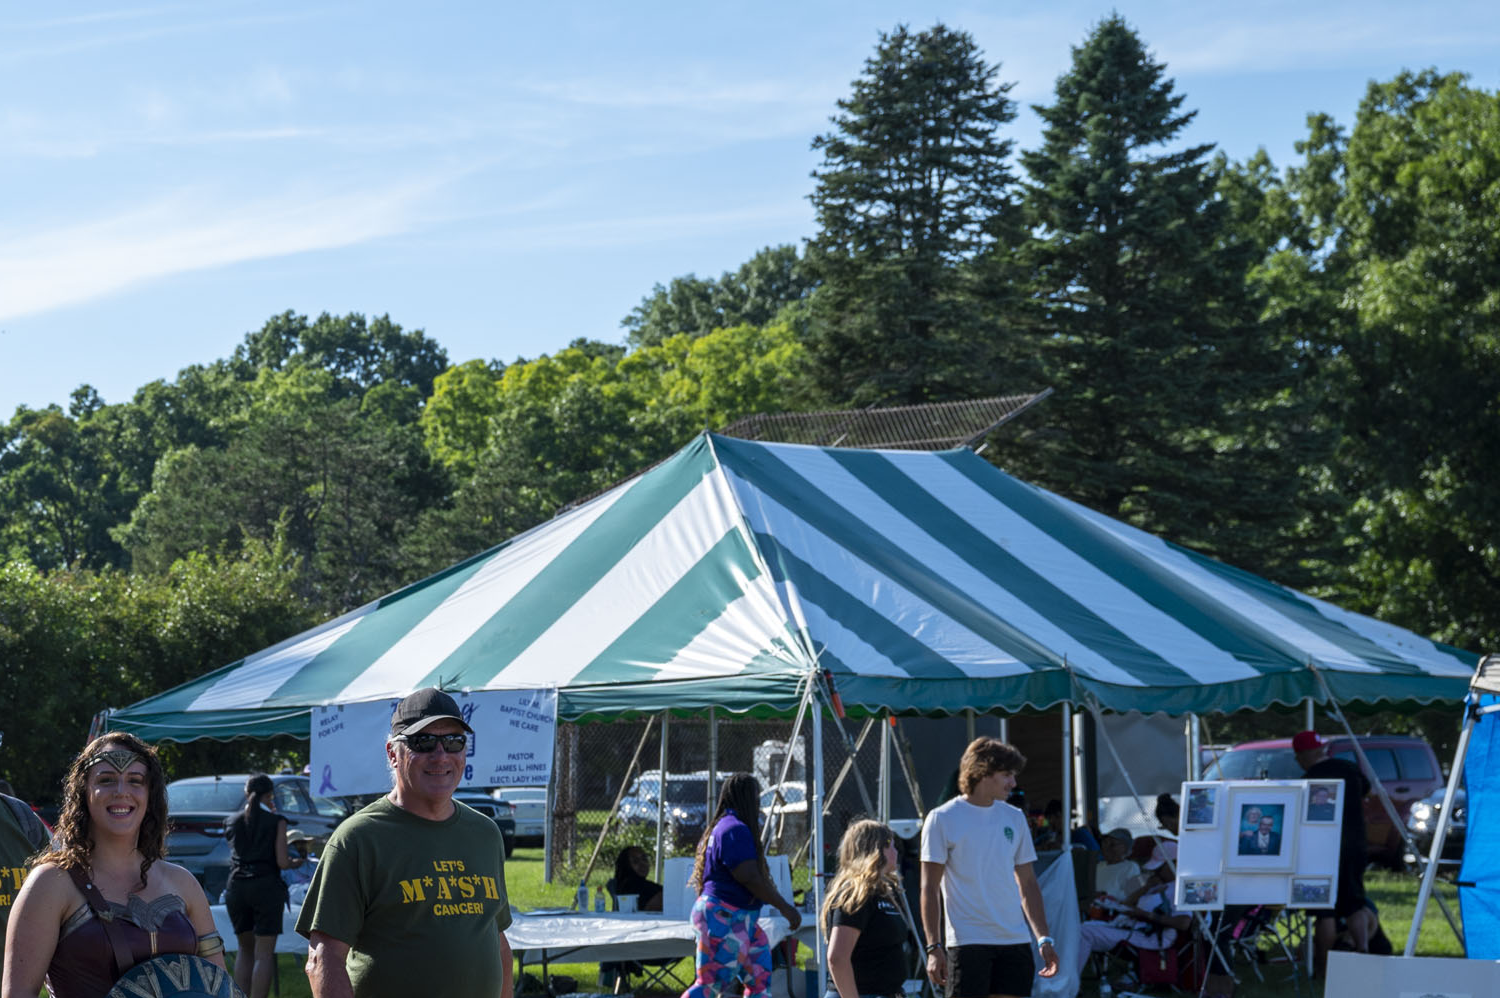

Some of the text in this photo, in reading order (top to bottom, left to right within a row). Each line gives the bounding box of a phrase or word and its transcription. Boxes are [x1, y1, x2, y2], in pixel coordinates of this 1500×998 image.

[500, 704, 526, 718] BAPTIST
[320, 714, 339, 727] RELAY
[510, 719, 539, 732] WE CARE
[318, 722, 345, 739] FOR LIFE
[507, 752, 534, 760] PASTOR
[495, 763, 517, 772] JAMES
[525, 763, 547, 772] HINES
[512, 775, 530, 784] LADY
[433, 860, 466, 872] LET'S
[433, 902, 484, 916] CANCER!
